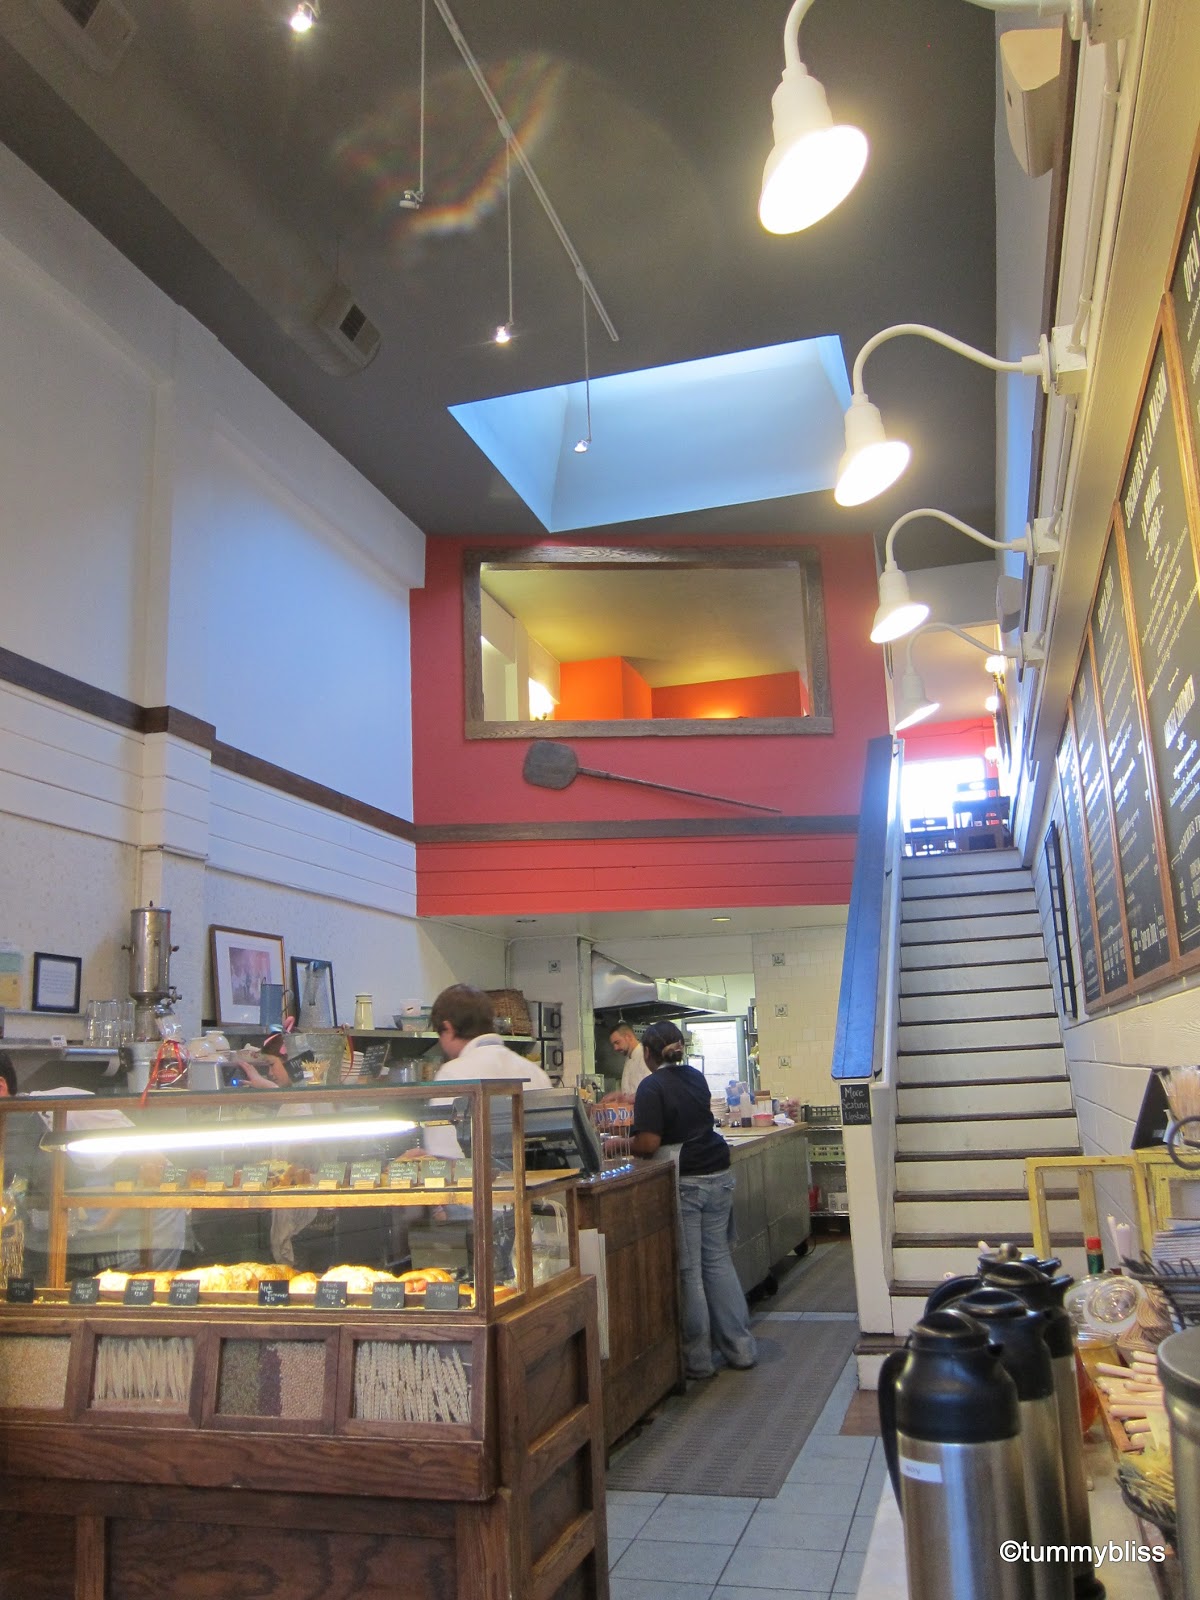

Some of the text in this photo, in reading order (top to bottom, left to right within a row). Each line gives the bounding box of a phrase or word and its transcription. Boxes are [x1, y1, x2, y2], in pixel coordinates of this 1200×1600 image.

[1183, 230, 1200, 302] OPEN
[844, 1086, 865, 1099] More
[841, 1098, 869, 1109] Seating
